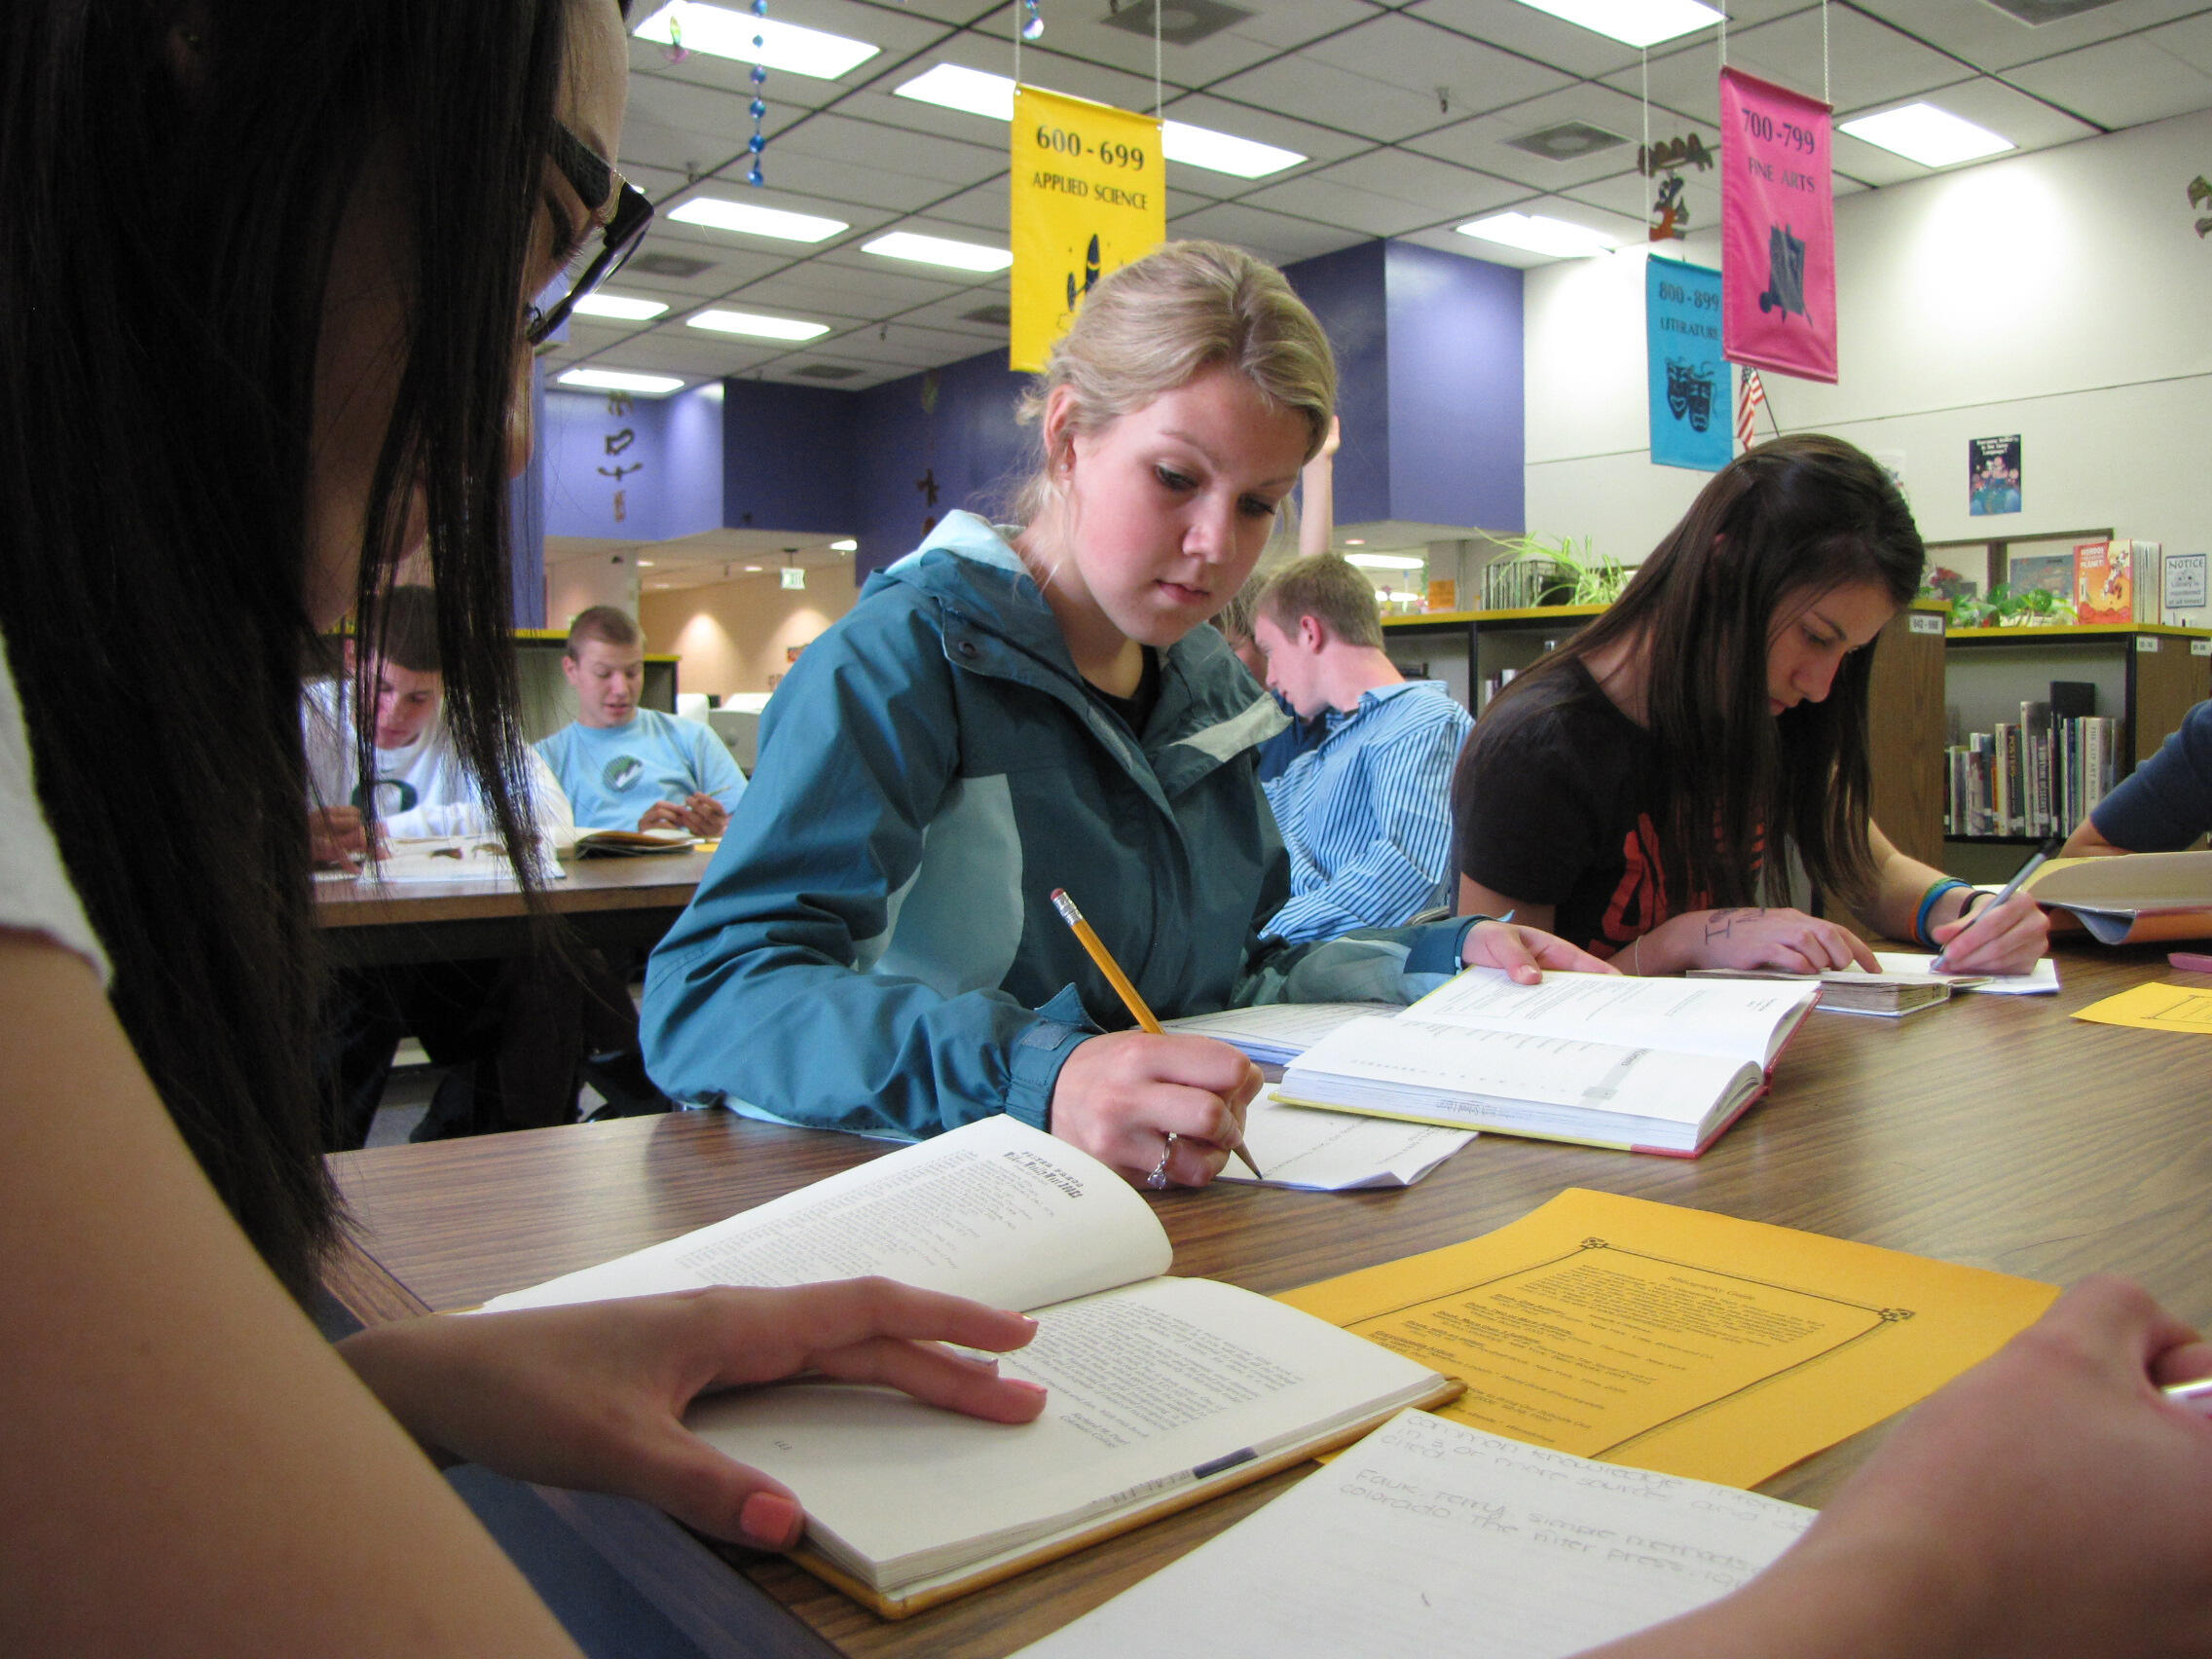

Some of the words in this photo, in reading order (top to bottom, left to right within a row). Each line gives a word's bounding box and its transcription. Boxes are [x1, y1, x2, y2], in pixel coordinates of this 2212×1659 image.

[1749, 157, 1774, 182] FINE
[1781, 169, 1816, 193] ARTS
[1032, 171, 1088, 197] APPLIED
[1094, 184, 1149, 211] SCIENCE
[1660, 317, 1719, 341] LITERATURE
[2168, 559, 2203, 570] NOTICE
